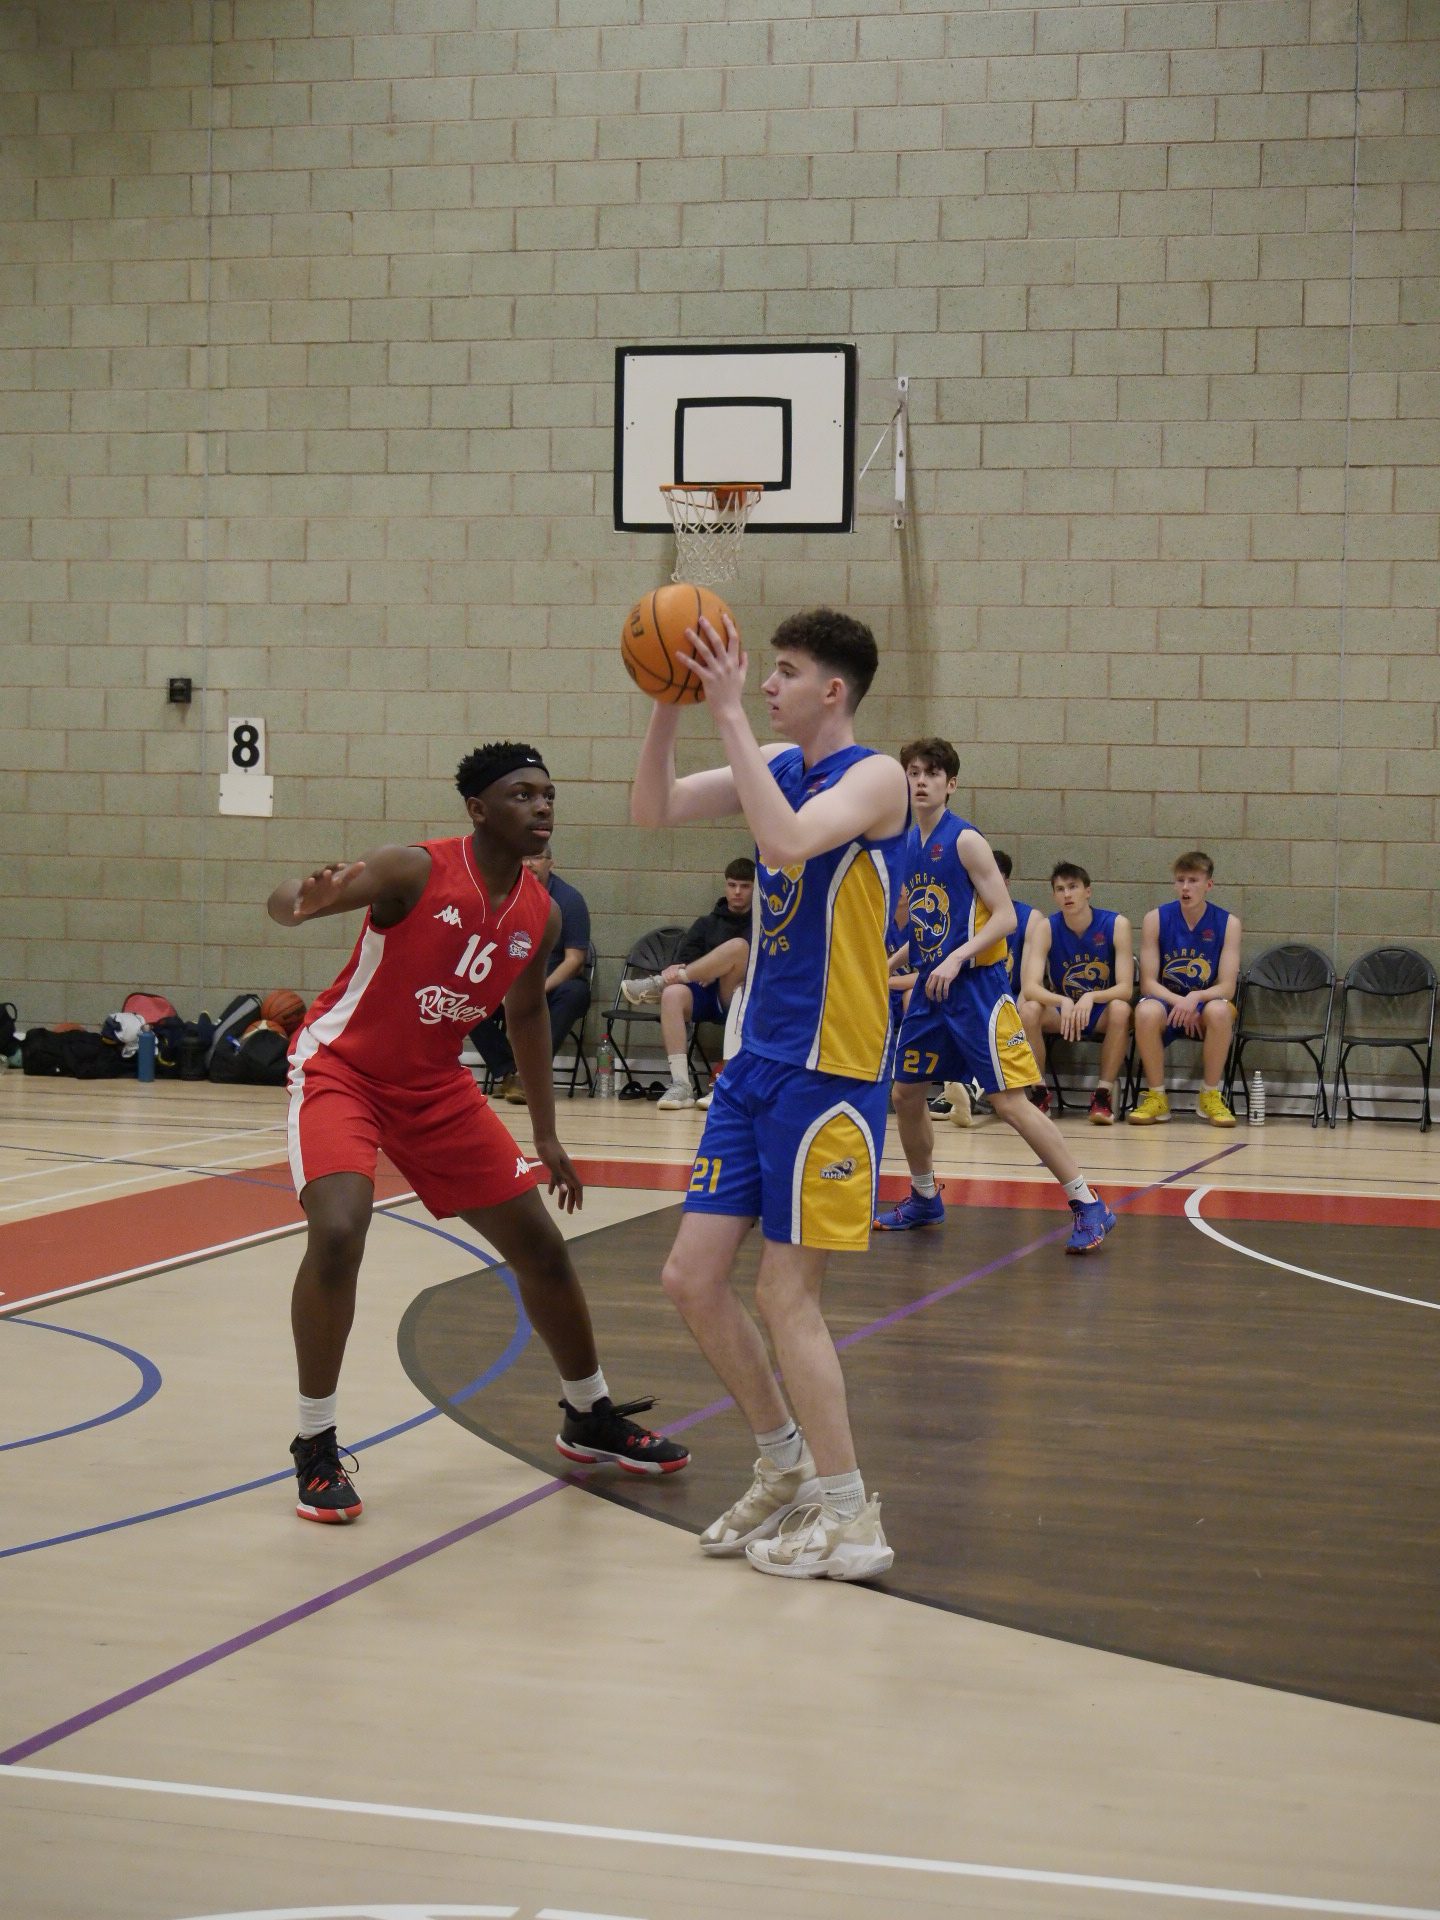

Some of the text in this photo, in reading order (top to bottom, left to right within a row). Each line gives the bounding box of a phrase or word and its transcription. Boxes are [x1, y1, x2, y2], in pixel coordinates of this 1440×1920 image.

[232, 725, 260, 768] 8
[454, 934, 498, 984] 16
[903, 1050, 939, 1075] 27
[689, 1157, 722, 1194] 21
